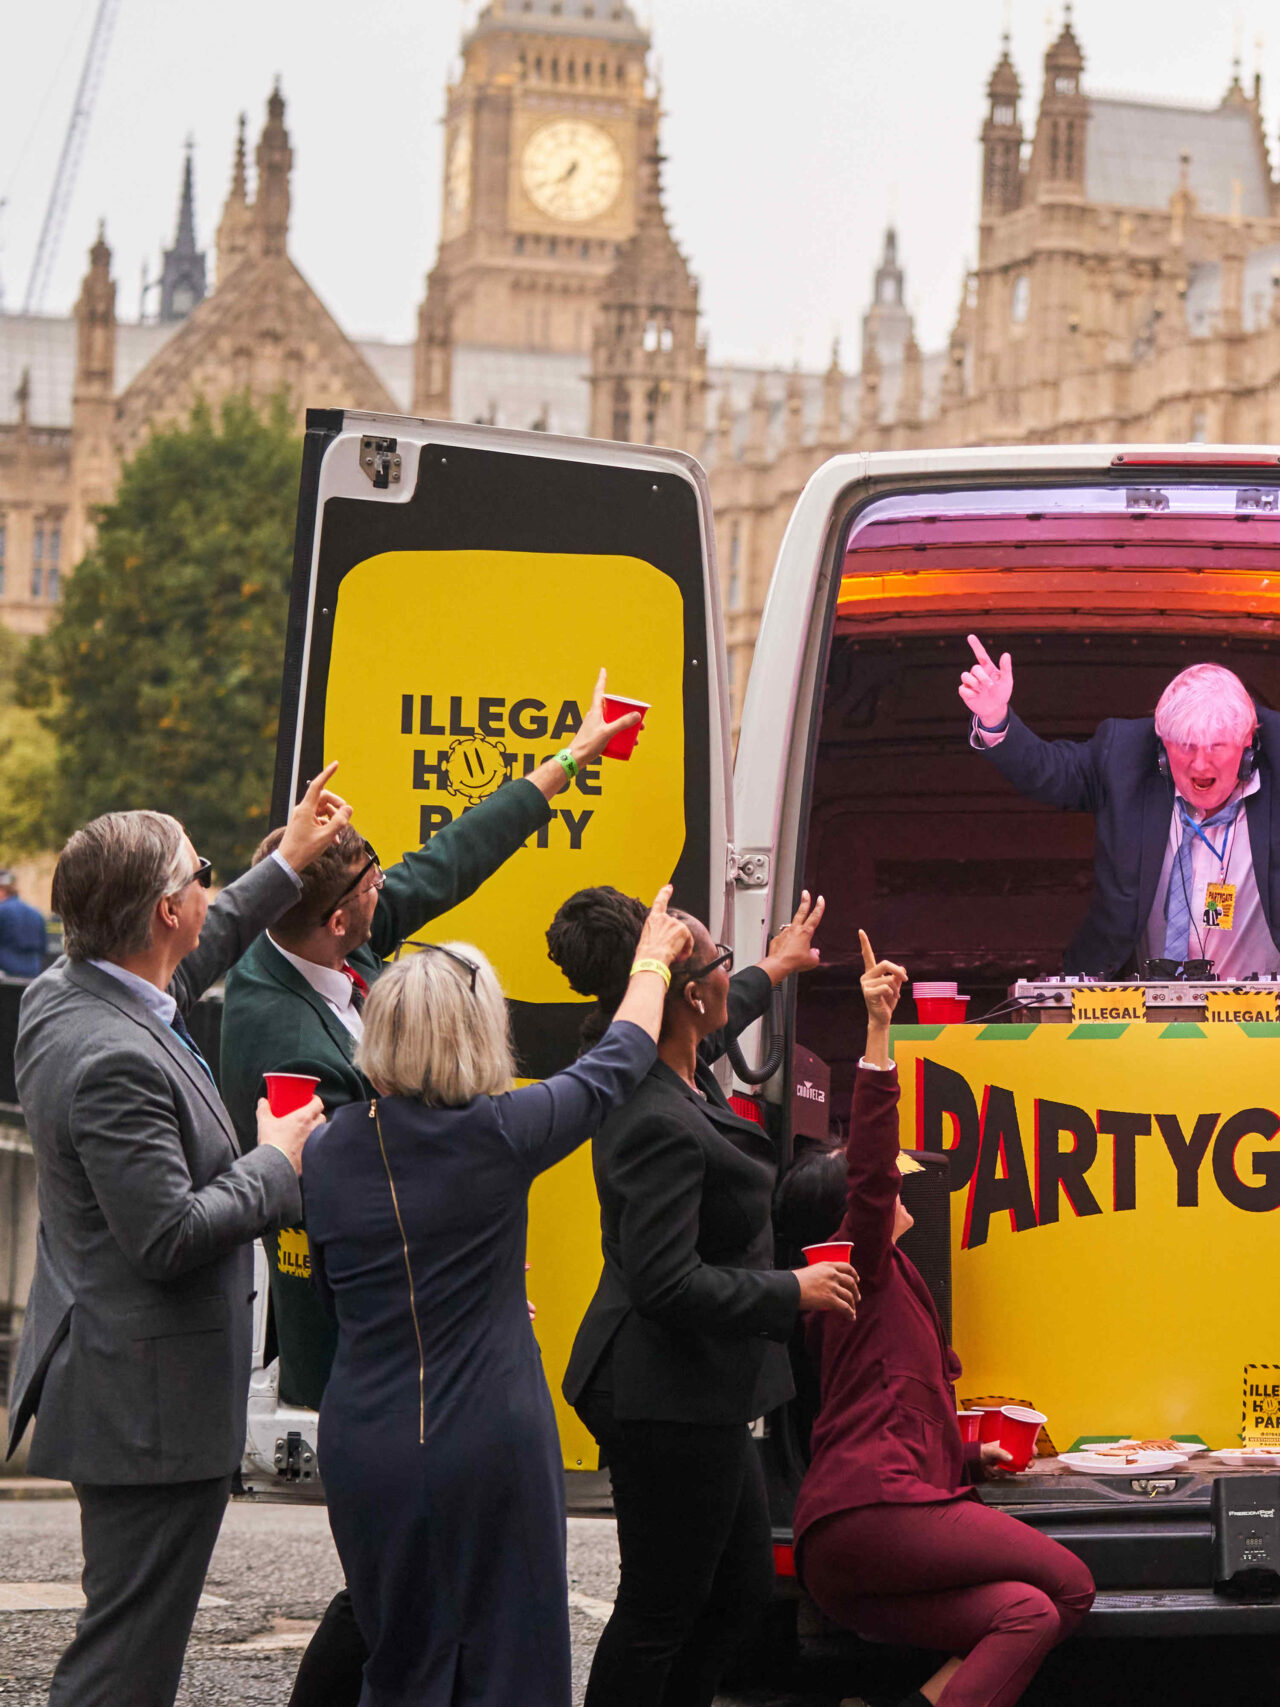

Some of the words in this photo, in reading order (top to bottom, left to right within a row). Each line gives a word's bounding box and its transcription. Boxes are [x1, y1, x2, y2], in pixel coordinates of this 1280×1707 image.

[401, 694, 585, 739] ILLEGA
[419, 805, 594, 850] PTY
[1078, 1007, 1141, 1020] ILLEGAL
[1211, 1010, 1274, 1023] ILLEGAL
[283, 1250, 311, 1270] ILLE
